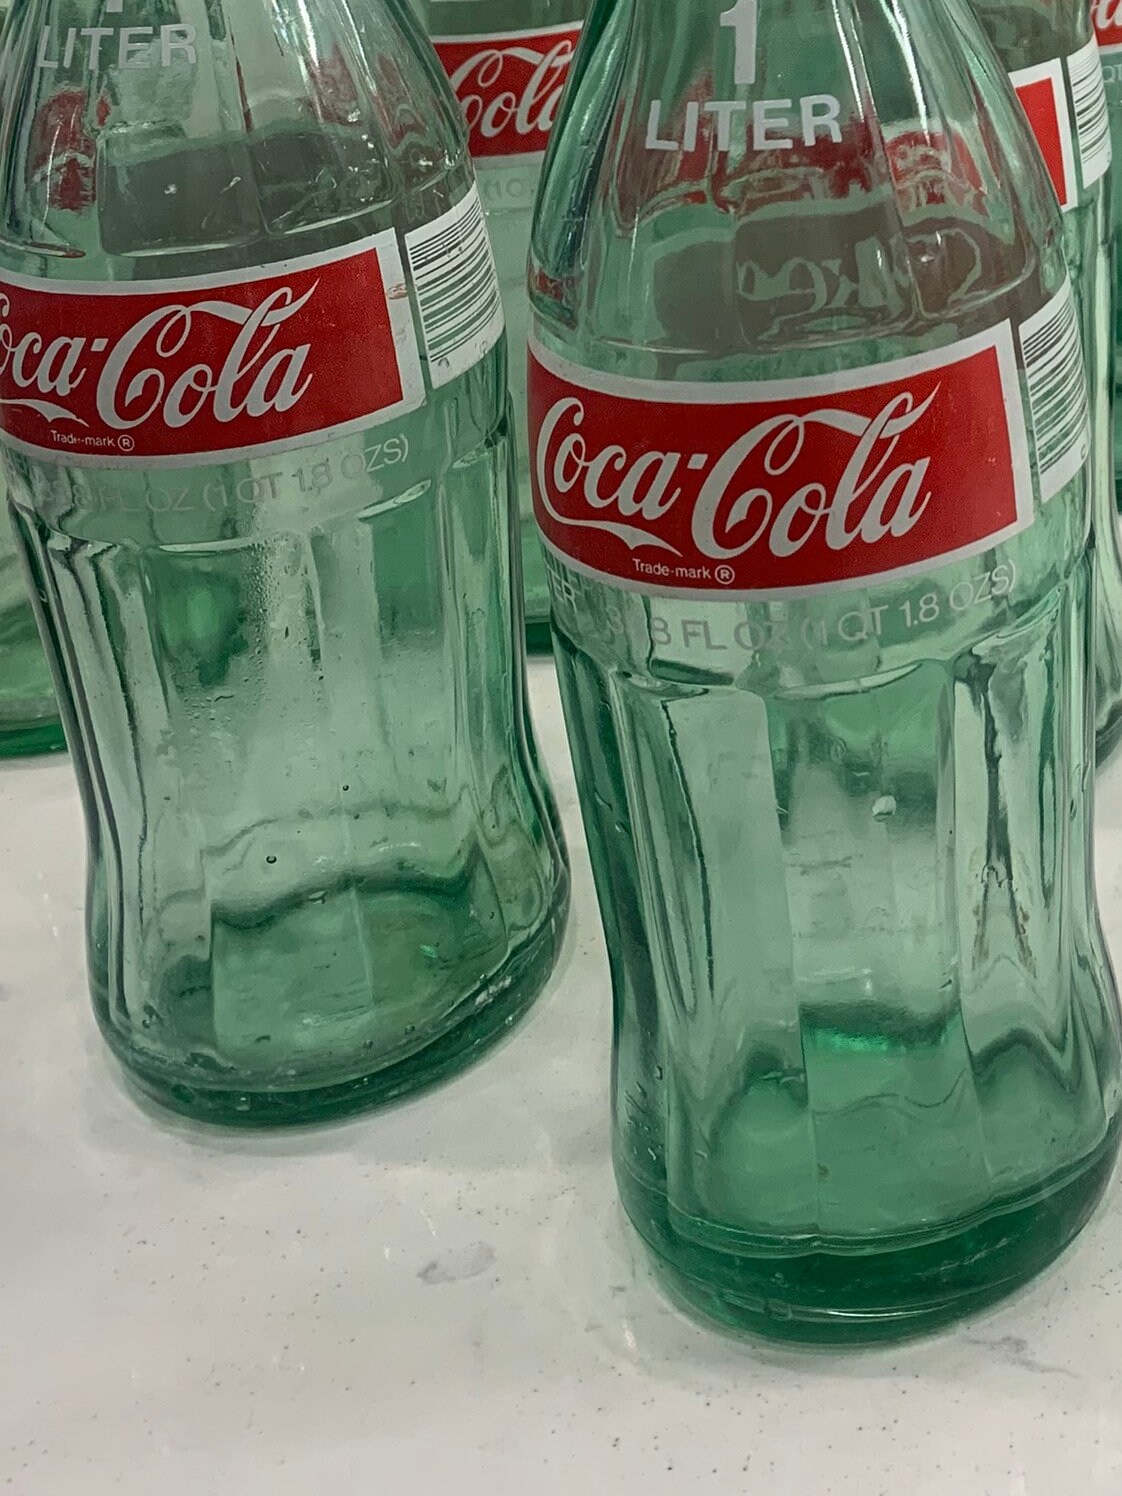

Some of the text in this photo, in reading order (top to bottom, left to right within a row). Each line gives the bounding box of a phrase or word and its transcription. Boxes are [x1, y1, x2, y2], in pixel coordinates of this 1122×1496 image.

[36, 23, 198, 70] LITER
[644, 93, 843, 153] LITER
[0, 277, 321, 429] oca-Cola
[146, 486, 195, 512] OZ
[236, 470, 284, 505] QT
[291, 461, 334, 493] 1.8
[341, 432, 410, 480] OZS)
[535, 381, 942, 559] Coca-Cola
[632, 557, 712, 580] Trade-mark
[680, 618, 728, 651] FL
[837, 605, 890, 642] QT
[901, 593, 941, 629] 1.8
[949, 558, 1018, 613] OZS)
